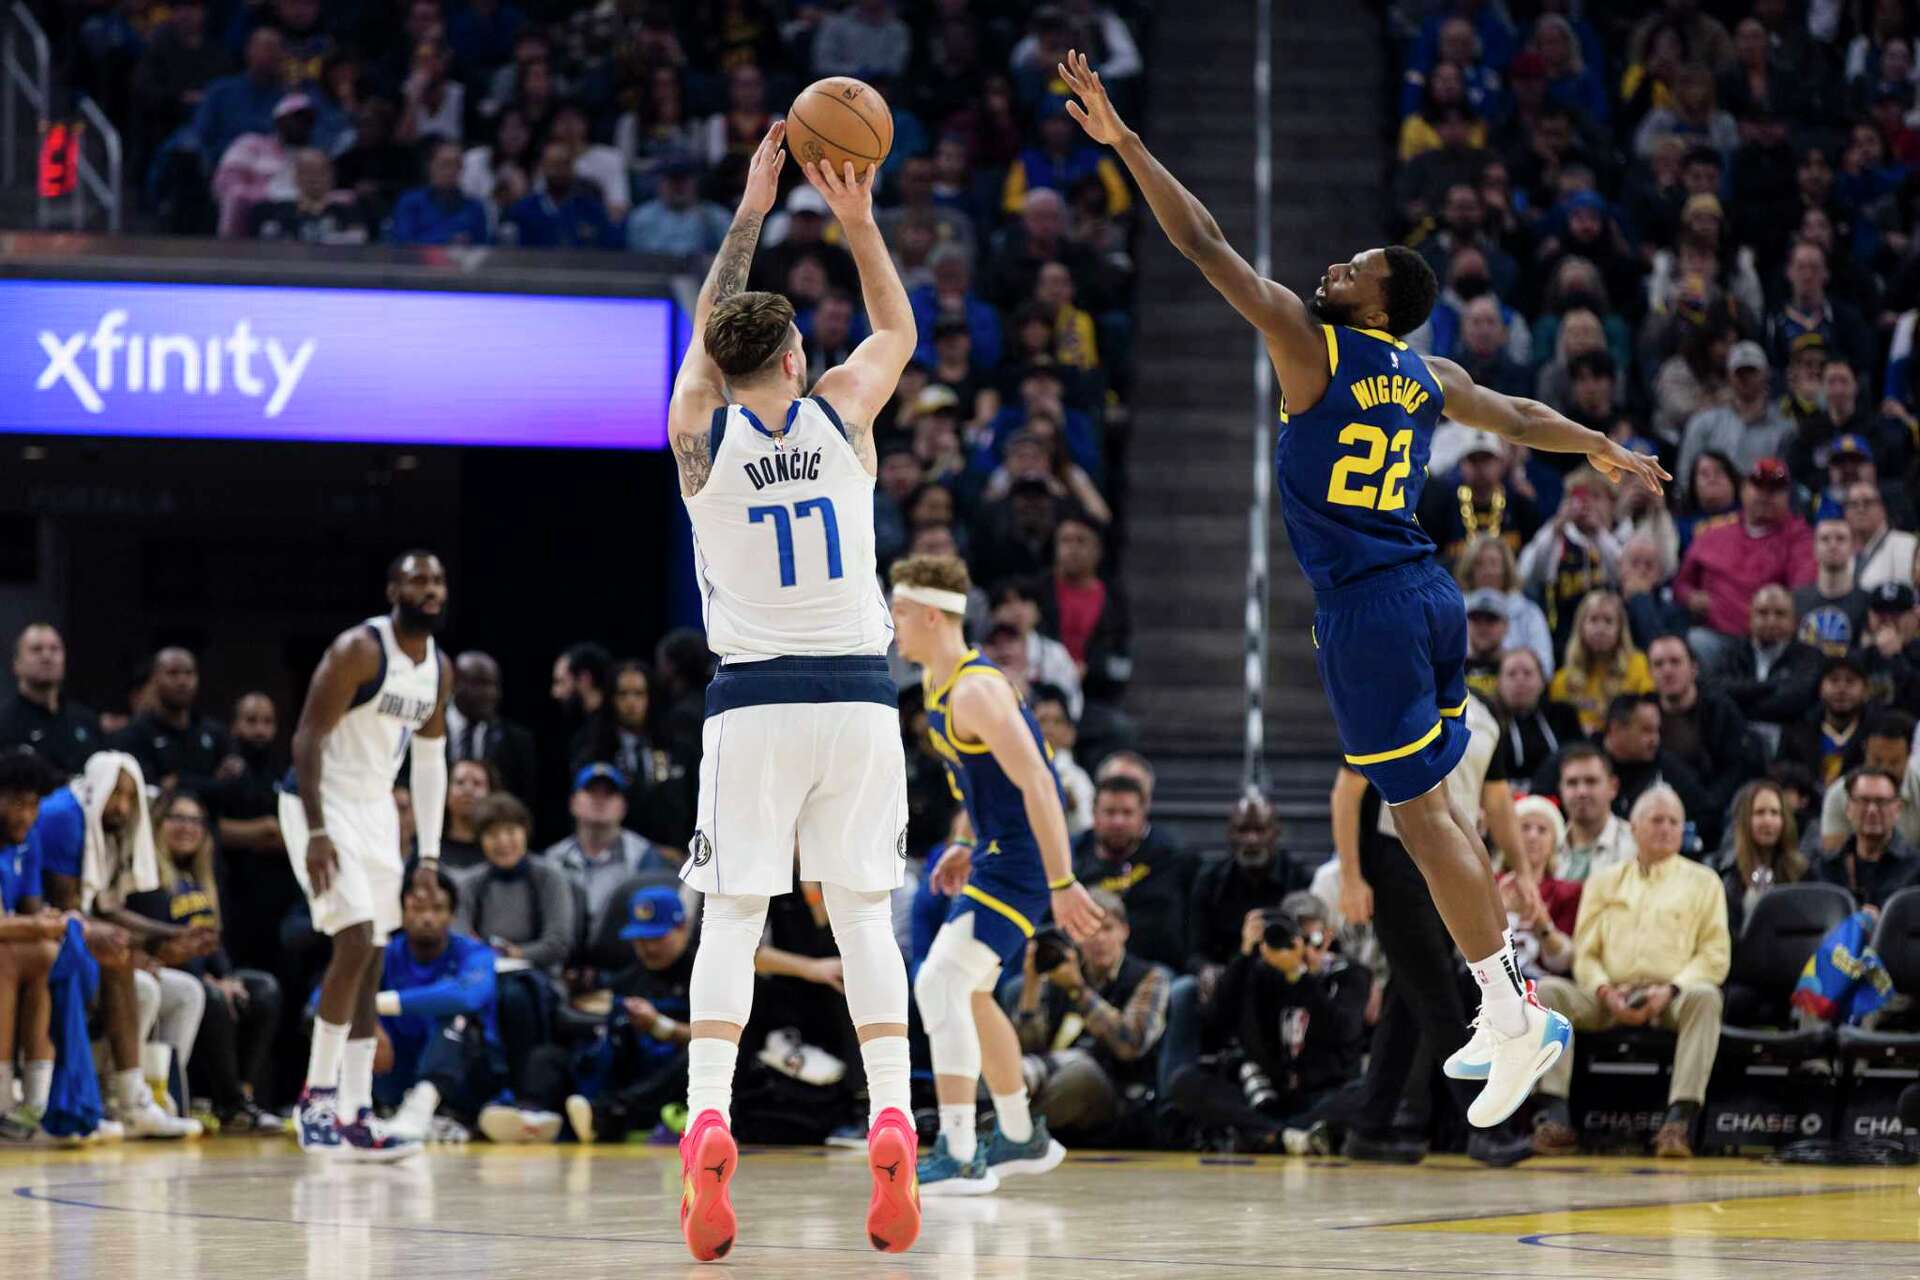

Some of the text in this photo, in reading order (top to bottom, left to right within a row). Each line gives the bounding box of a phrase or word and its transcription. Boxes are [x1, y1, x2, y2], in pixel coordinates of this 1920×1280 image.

[36, 309, 316, 417] xfinity
[1350, 375, 1429, 415] WIGGINS
[743, 447, 822, 490] DONČIĆ
[1327, 422, 1414, 511] 22
[748, 497, 844, 588] 77
[1716, 1113, 1796, 1132] CHASE
[1854, 1116, 1918, 1136] CHA
